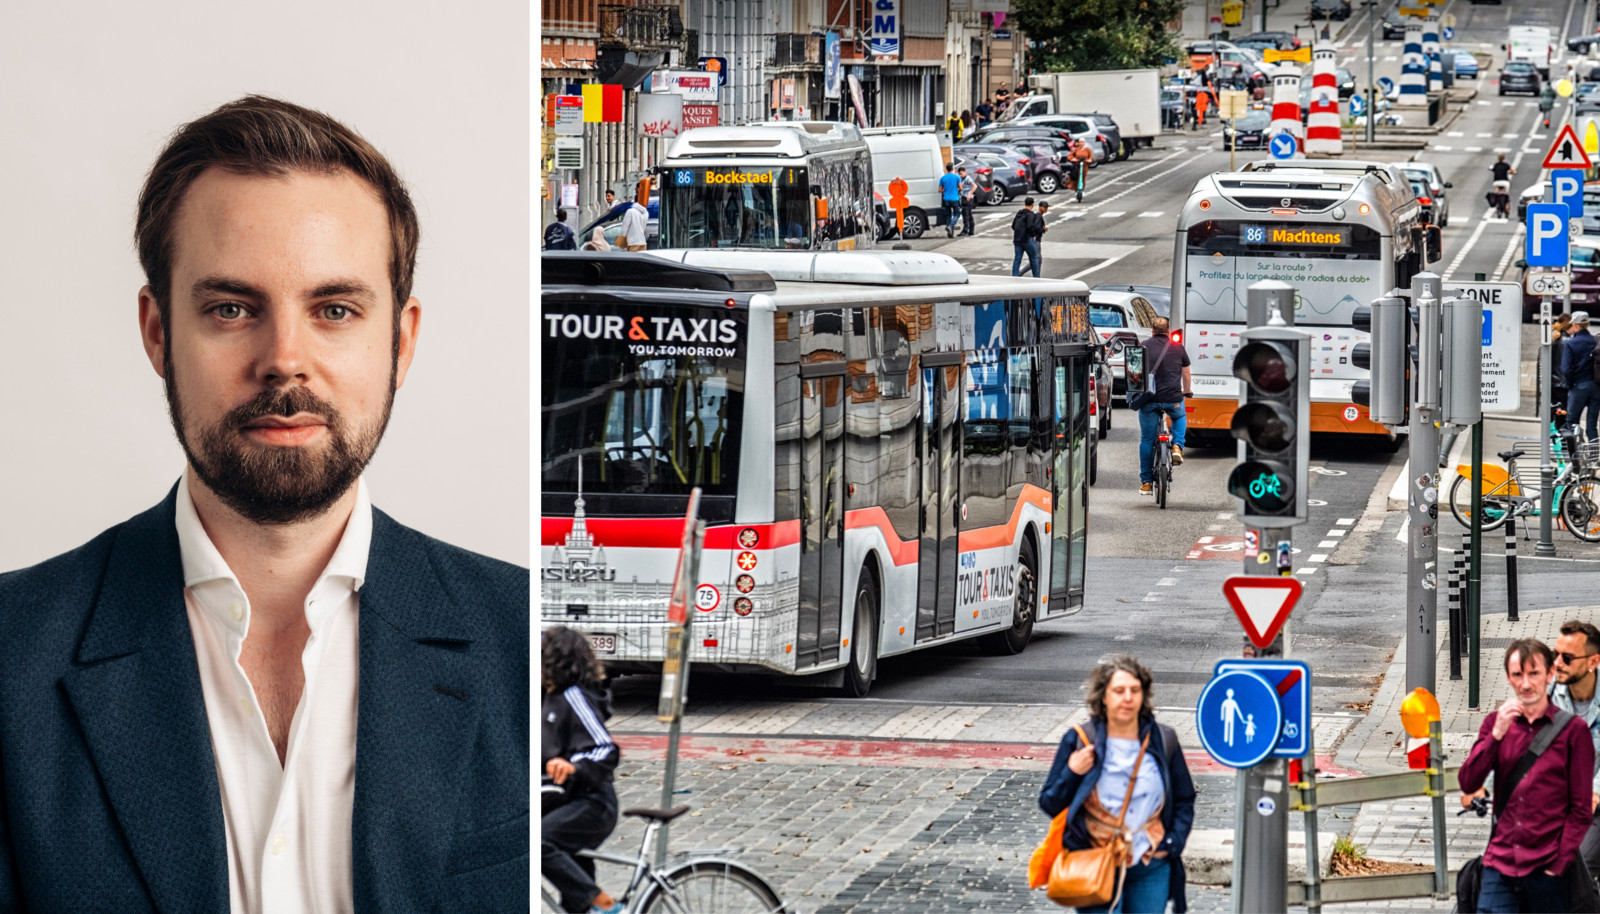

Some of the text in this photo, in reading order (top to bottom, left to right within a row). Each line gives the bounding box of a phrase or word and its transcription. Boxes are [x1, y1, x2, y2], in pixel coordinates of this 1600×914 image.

[875, 15, 895, 33] M
[683, 107, 713, 116] AQUES
[683, 116, 712, 124] ANSIT
[678, 171, 691, 184] 86
[705, 170, 773, 184] Bockstael
[1556, 177, 1578, 204] P
[1247, 228, 1341, 244] 86 Machtens
[1533, 213, 1562, 256] P
[1257, 262, 1271, 271] Sur
[1273, 263, 1281, 271] la
[1199, 271, 1371, 283] Profitez du large choix de radios du dab+
[1459, 288, 1502, 305] ONE
[544, 313, 738, 343] TOUR & TAXIS
[1481, 381, 1496, 389] end
[1346, 408, 1356, 416] 75
[959, 570, 983, 607] TOUR
[990, 564, 1014, 600] TAXIS
[700, 590, 713, 600] 75
[591, 637, 613, 649] 389
